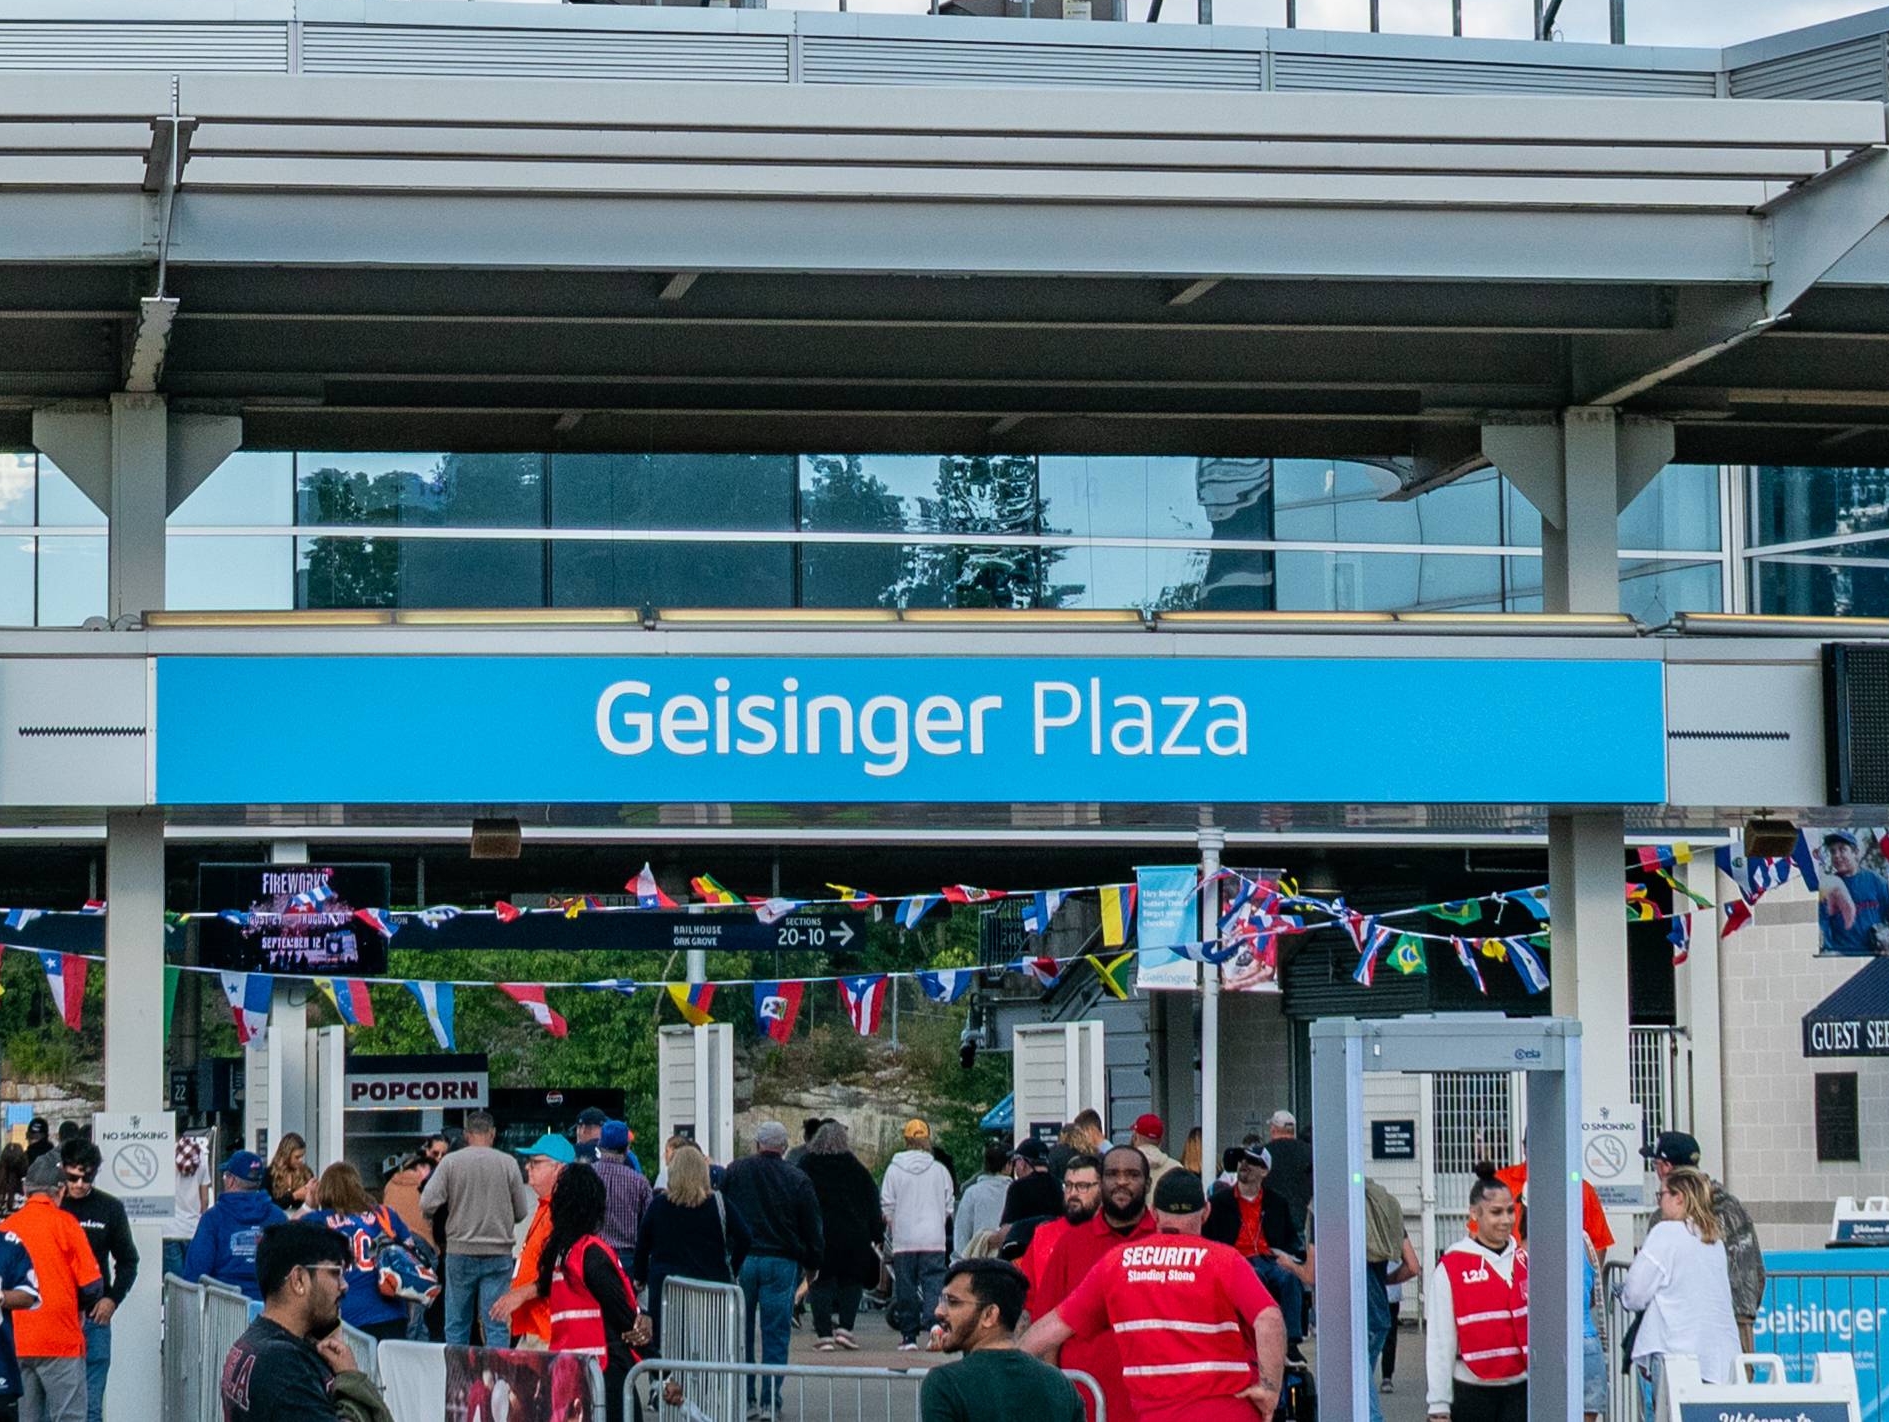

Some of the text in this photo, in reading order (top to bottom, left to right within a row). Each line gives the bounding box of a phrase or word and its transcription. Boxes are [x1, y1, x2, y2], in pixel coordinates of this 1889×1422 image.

[596, 677, 1247, 776] Geisinger Plaza
[261, 872, 329, 895] FIREWORKS
[673, 925, 722, 935] RAILHOUSE
[785, 917, 822, 926] SECTIONS
[261, 937, 322, 949] SEPTEMBER 12
[673, 937, 718, 946] OAK GROVE
[778, 928, 825, 946] 20-10
[1812, 1020, 1860, 1051] GUEST
[175, 1084, 187, 1101] 22
[351, 1081, 479, 1101] POPCORN
[103, 1131, 168, 1140] NO SMOKING
[1591, 1123, 1636, 1131] SMOKING
[1122, 1246, 1208, 1267] SECURITY
[1128, 1270, 1196, 1284] Standing Stone
[1752, 1303, 1887, 1340] Geisinger
